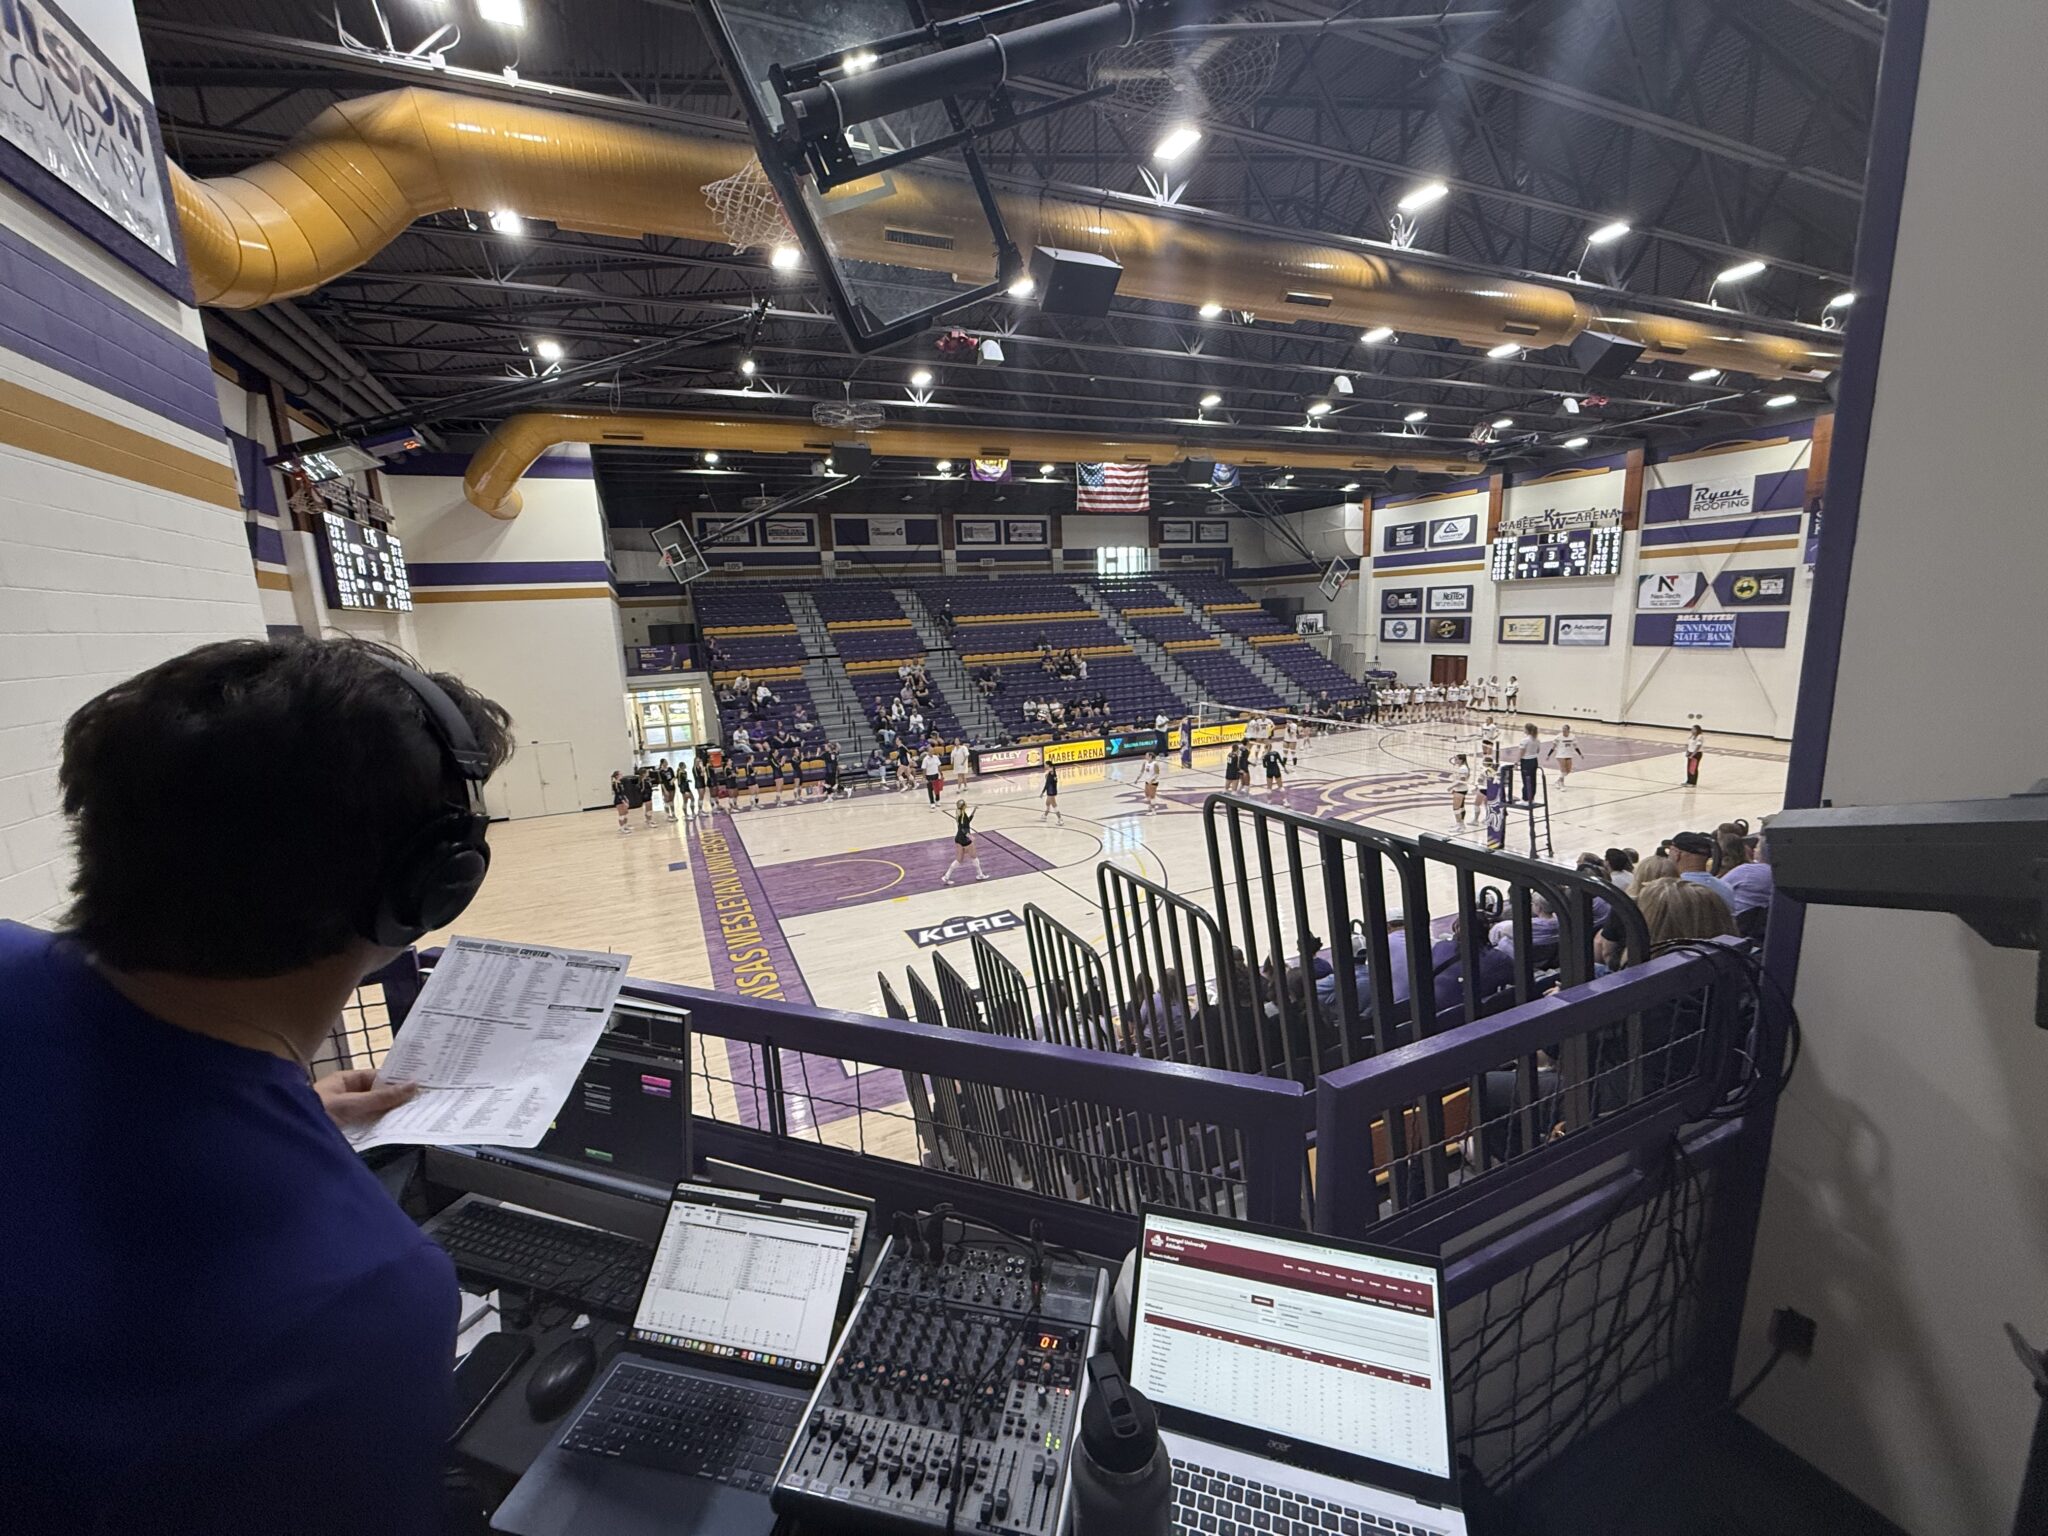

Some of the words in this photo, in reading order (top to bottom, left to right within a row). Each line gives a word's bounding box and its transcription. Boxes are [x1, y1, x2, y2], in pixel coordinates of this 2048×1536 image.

[1694, 487, 1744, 502] Ryan
[1693, 498, 1750, 512] ROOFING
[1500, 519, 1535, 529] MABEE
[1575, 508, 1618, 522] ARENA
[1525, 552, 1536, 562] 19
[1548, 551, 1555, 560] 3
[1571, 548, 1586, 560] 22
[1563, 567, 1571, 576] 2
[1675, 623, 1733, 632] BENNINGTON
[1673, 633, 1698, 641] STATE
[1707, 632, 1731, 641] BANK
[1193, 736, 1221, 745] WESLEYAN
[991, 751, 1021, 762] ALLEY
[1048, 751, 1076, 762] MABEE
[1077, 747, 1104, 759] ARENA
[711, 876, 763, 951] WESLEYAN
[919, 913, 1016, 944] KCAC
[1165, 1236, 1184, 1244] Evangel
[1184, 1239, 1208, 1250] University
[1040, 1336, 1058, 1349] 01
